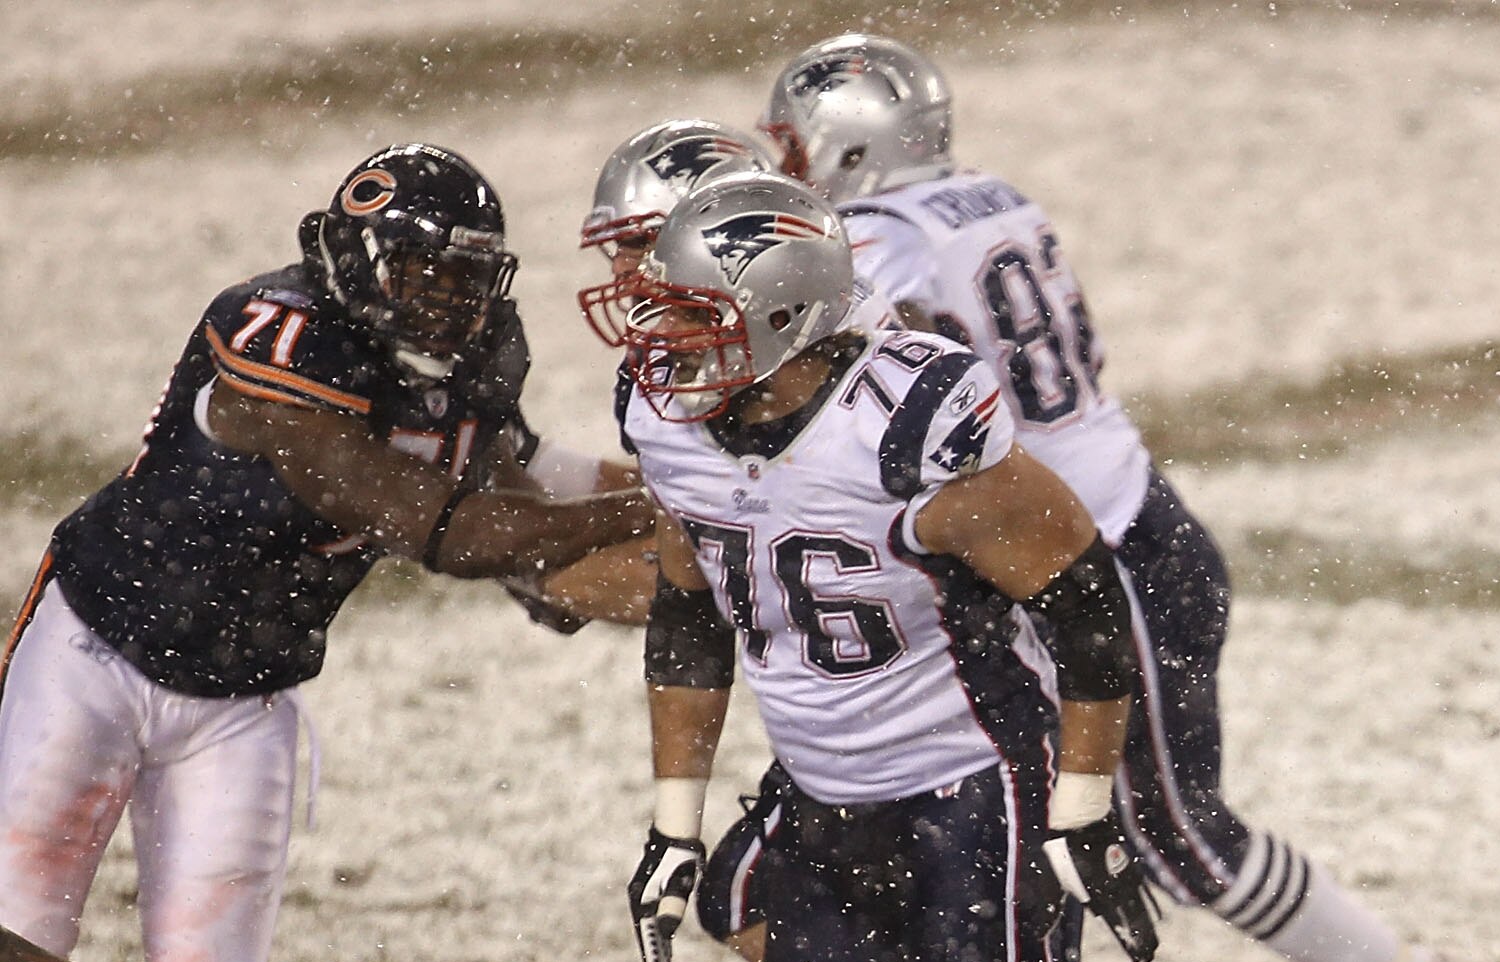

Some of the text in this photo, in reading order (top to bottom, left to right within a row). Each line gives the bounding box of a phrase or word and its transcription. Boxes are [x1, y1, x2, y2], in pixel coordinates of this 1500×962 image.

[341, 168, 398, 217] C
[229, 300, 310, 368] 71
[838, 332, 944, 419] 76
[672, 508, 908, 681] 76
